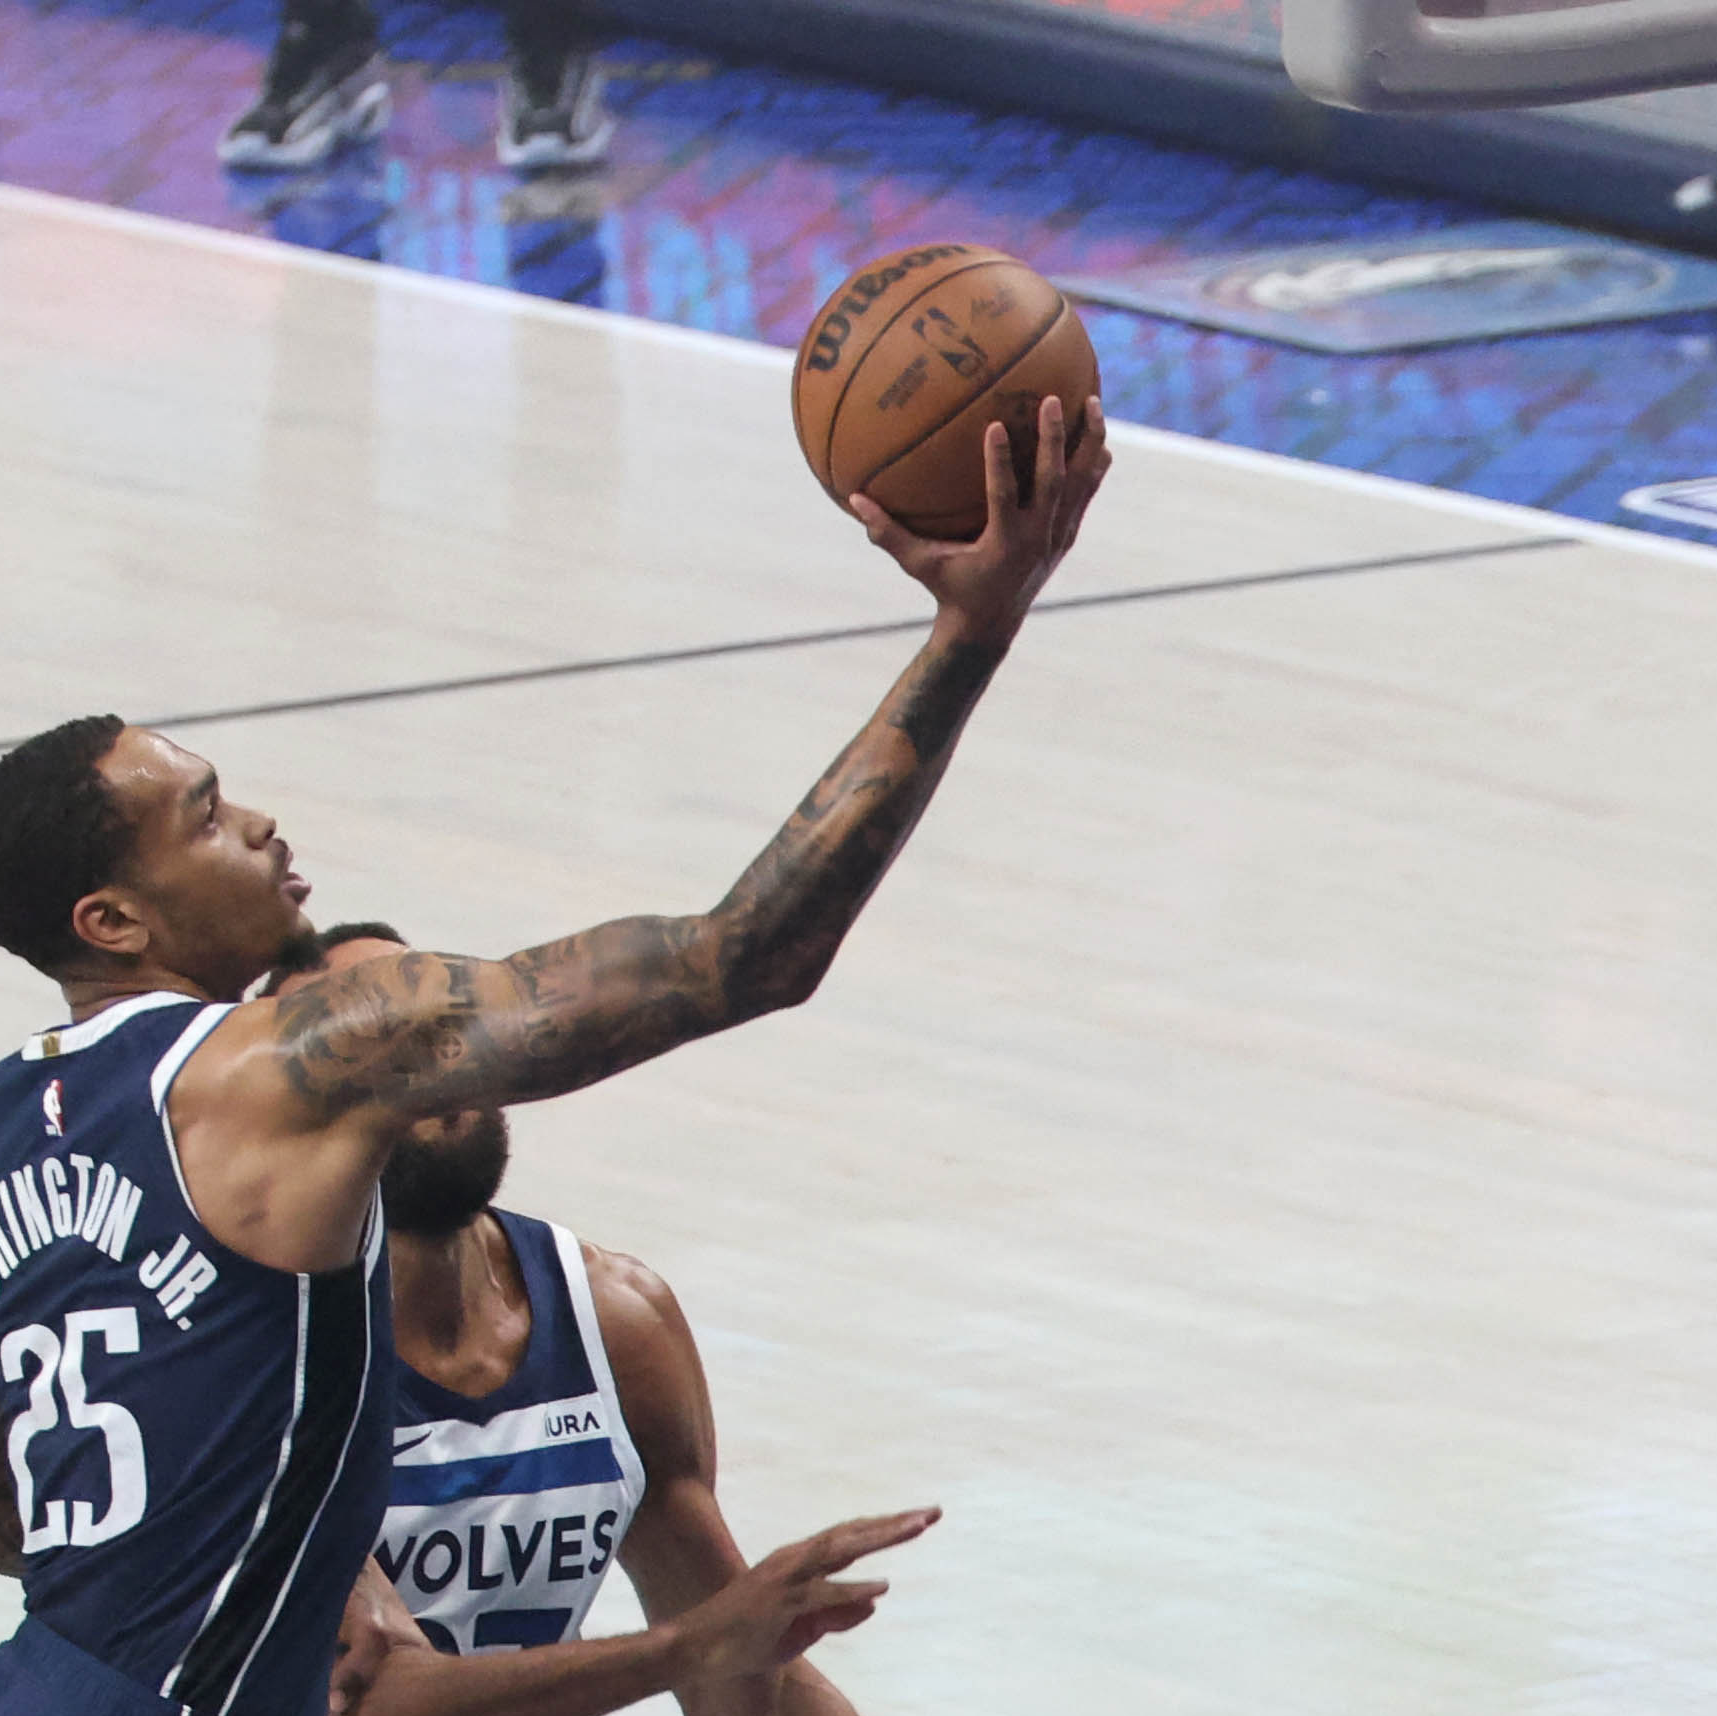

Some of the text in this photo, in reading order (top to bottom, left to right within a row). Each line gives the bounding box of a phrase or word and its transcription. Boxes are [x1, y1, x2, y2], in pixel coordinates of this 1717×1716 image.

[138, 1232, 218, 1331] JR.
[0, 1305, 148, 1555] 25
[545, 1410, 601, 1438] URA
